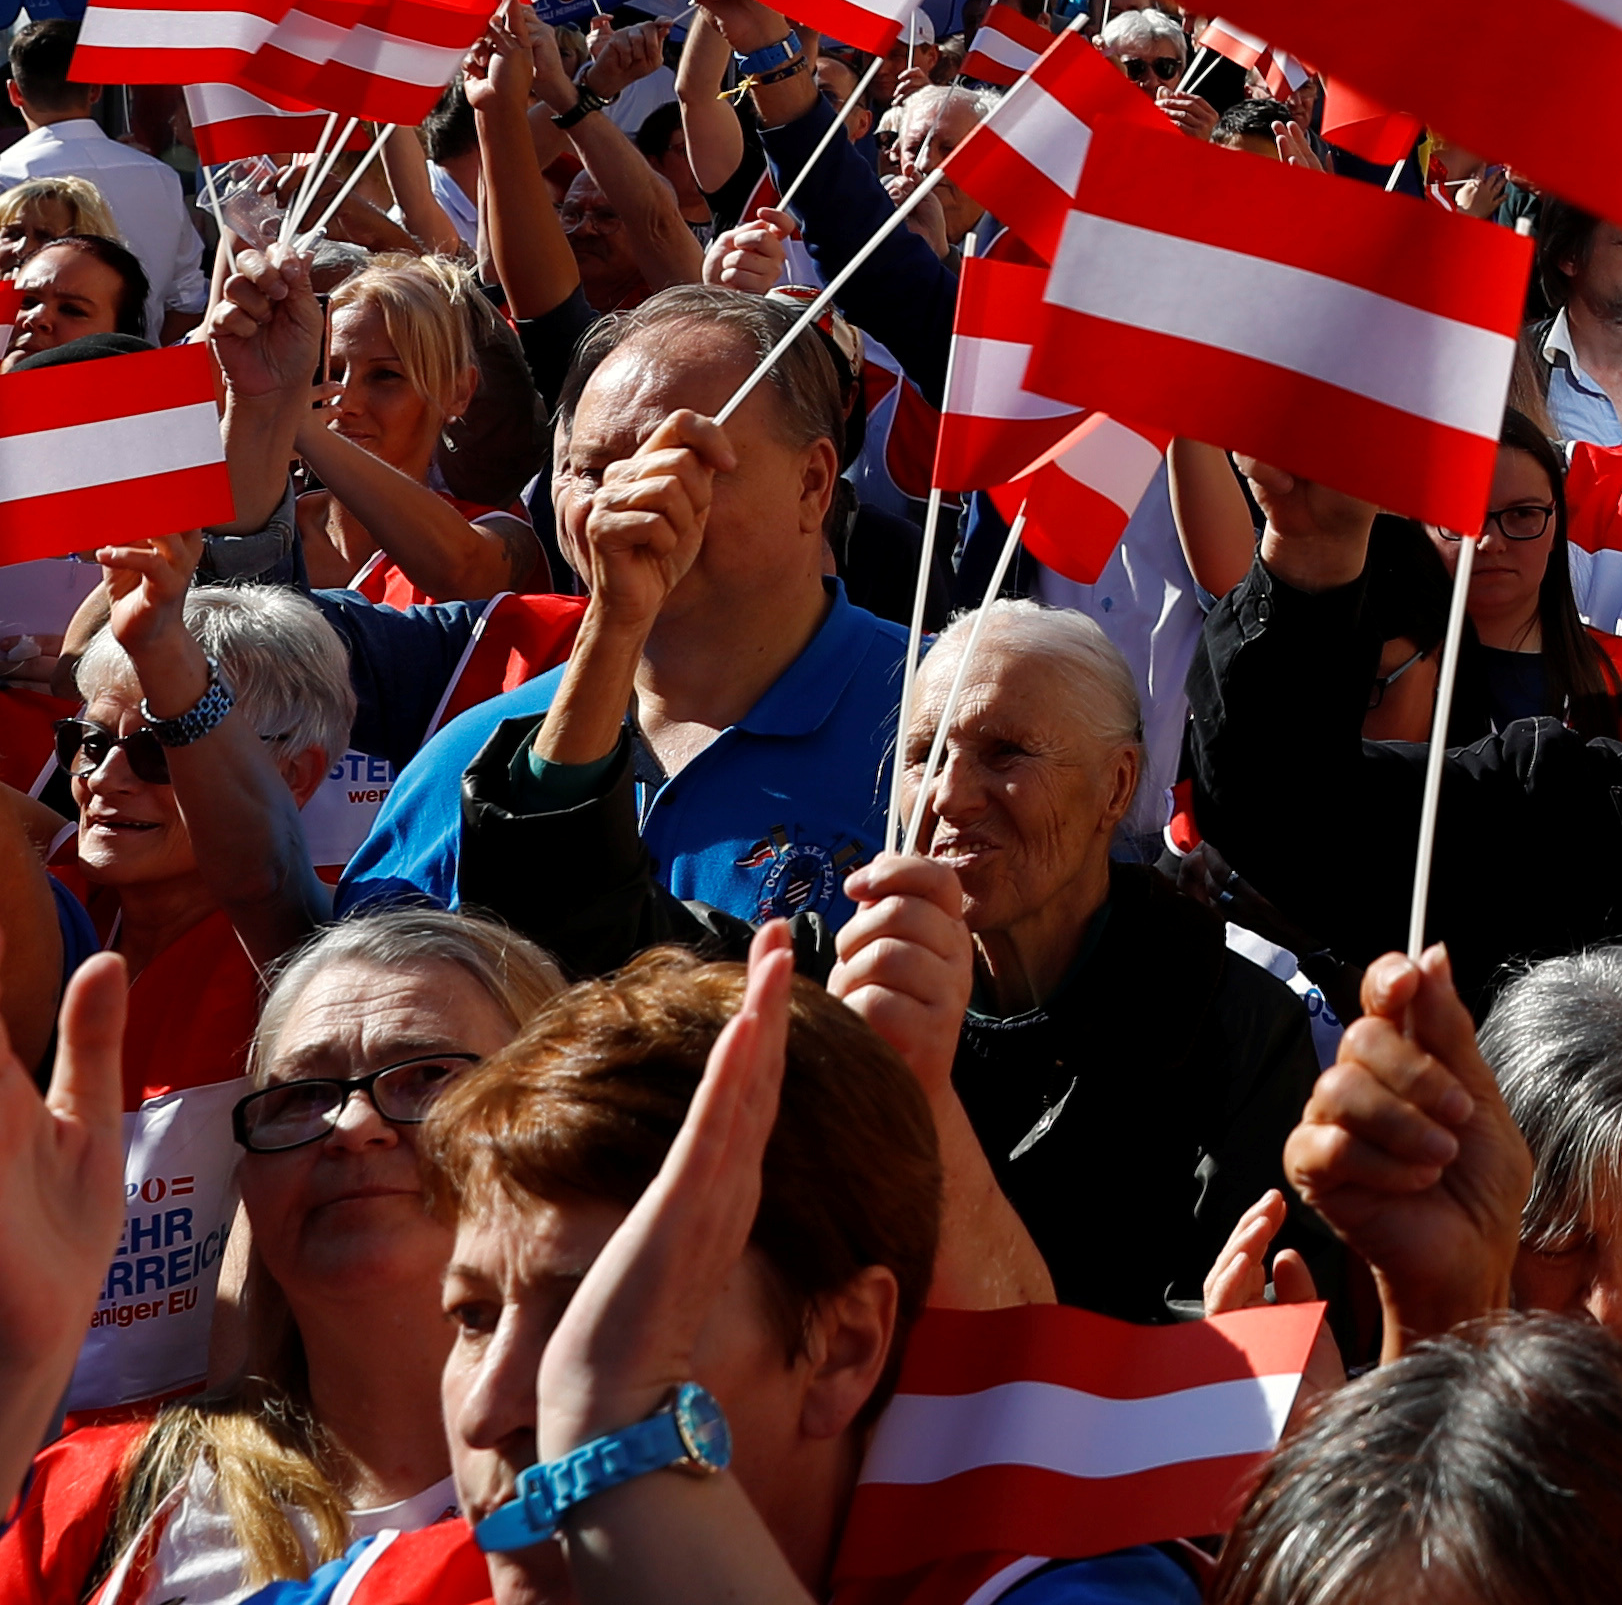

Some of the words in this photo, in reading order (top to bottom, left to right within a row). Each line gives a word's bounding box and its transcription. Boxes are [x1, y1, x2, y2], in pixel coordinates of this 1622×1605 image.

[803, 845, 827, 860] SEA
[820, 860, 834, 901] TEAM
[167, 1287, 198, 1315] EU
